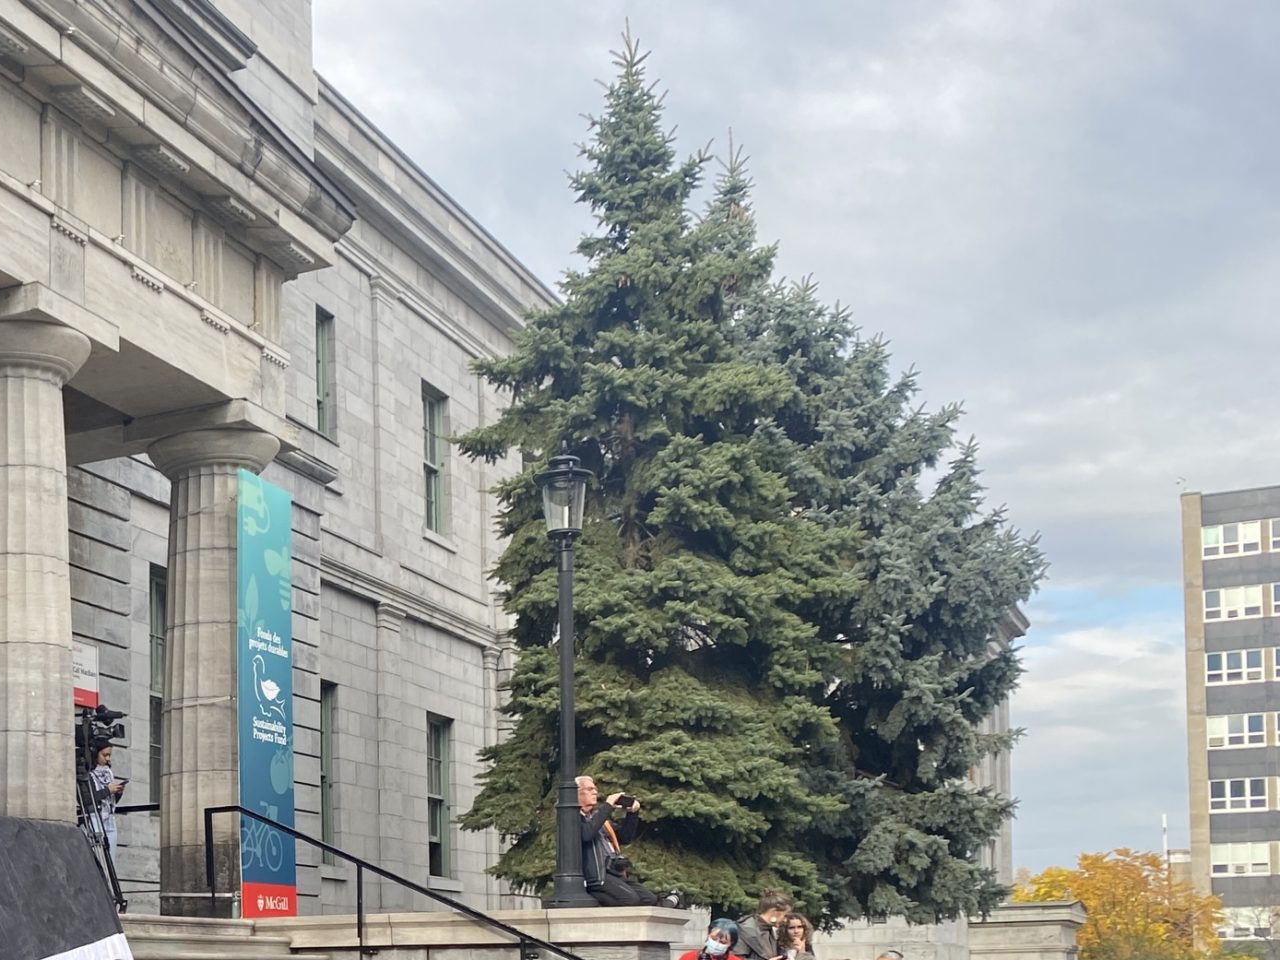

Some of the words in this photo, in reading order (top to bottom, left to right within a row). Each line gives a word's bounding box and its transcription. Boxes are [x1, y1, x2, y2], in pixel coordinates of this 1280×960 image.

[256, 626, 272, 642] Fonds
[272, 631, 281, 645] des
[248, 638, 268, 652] projets
[268, 641, 289, 659] durables
[252, 716, 287, 737] Sustainability
[252, 727, 274, 743] Projects
[274, 732, 287, 746] Fund
[265, 895, 289, 911] McGill
